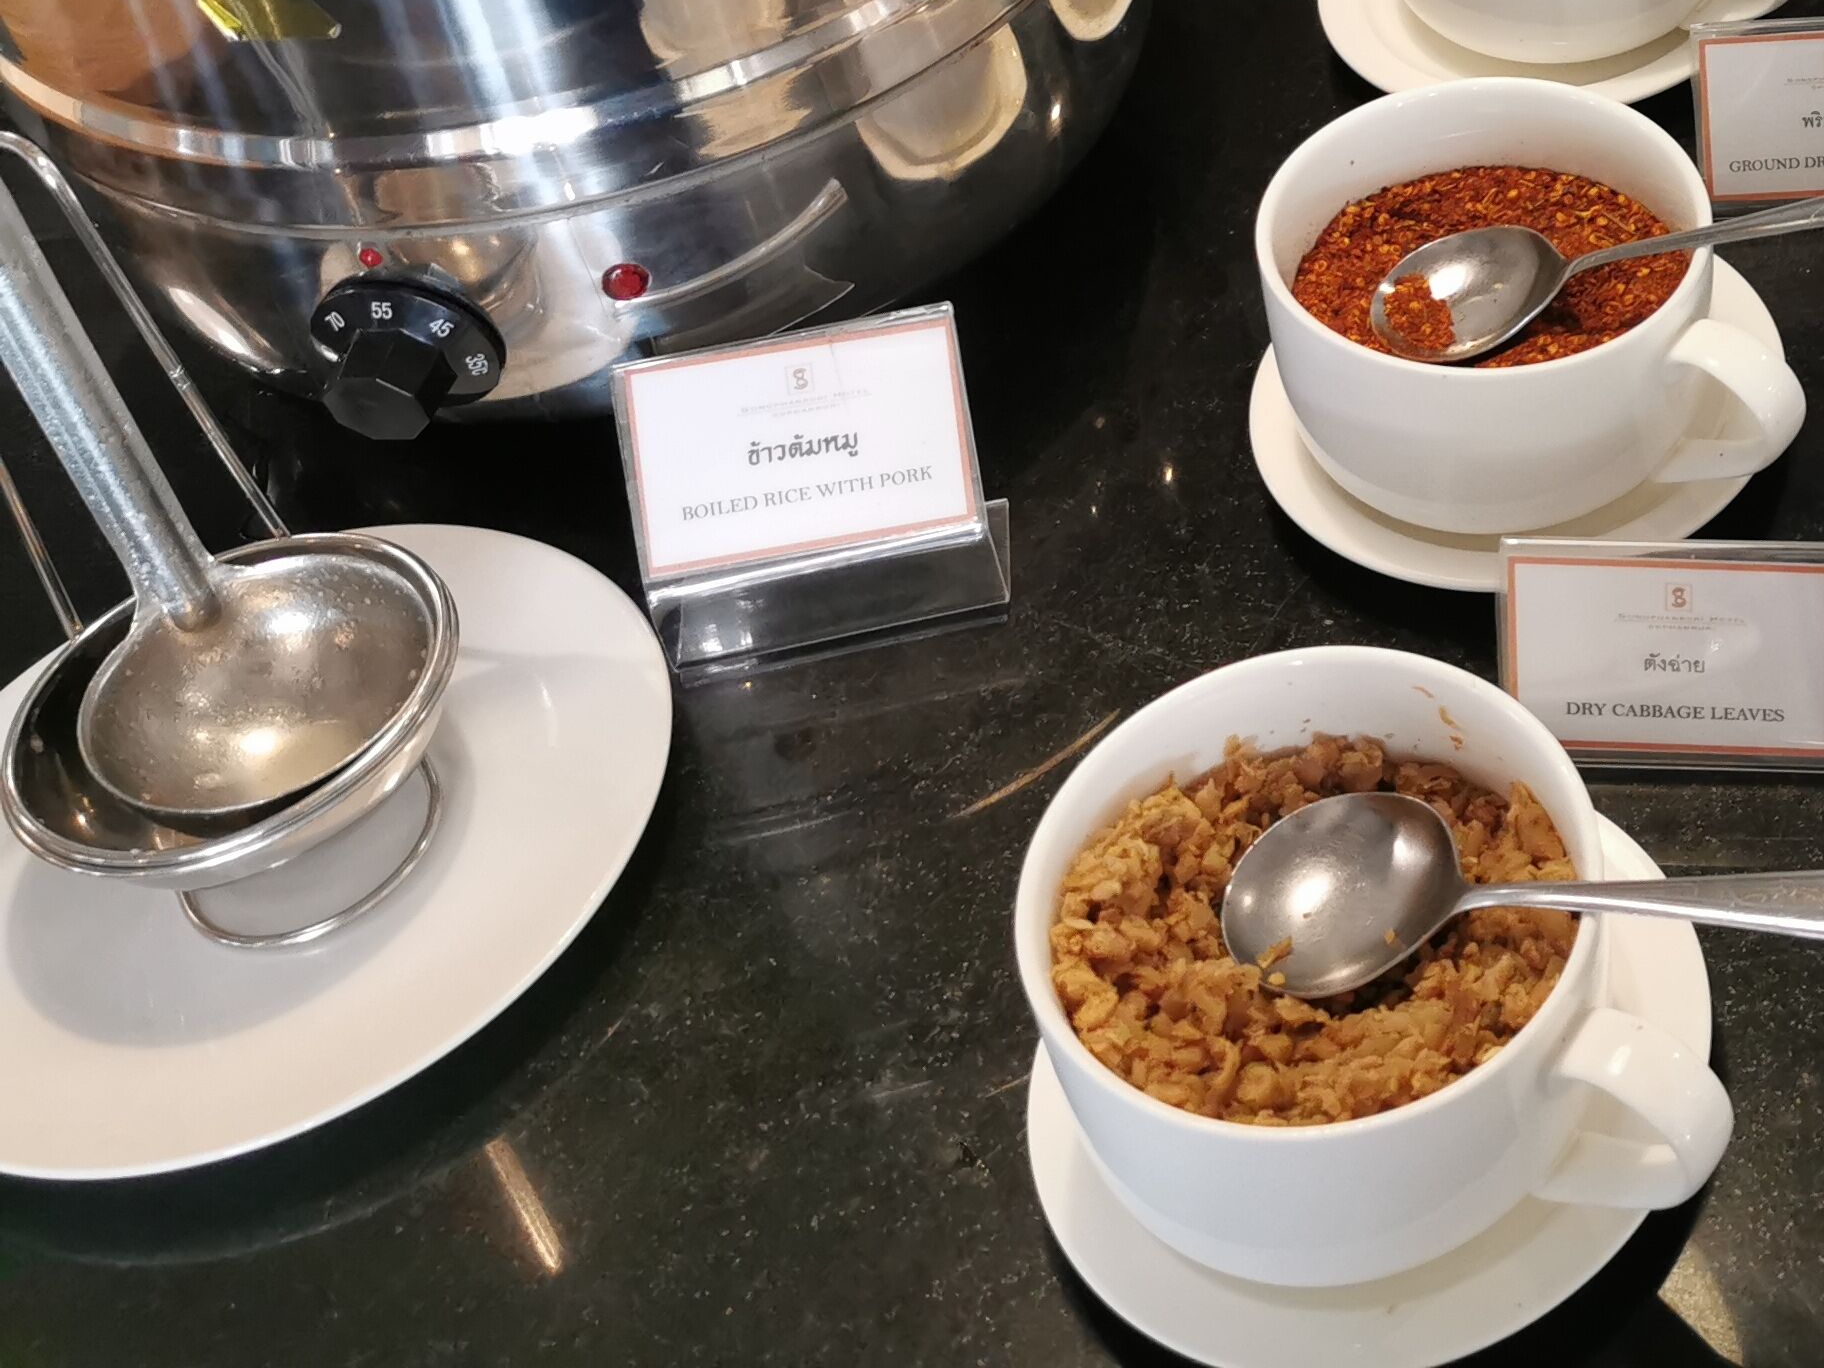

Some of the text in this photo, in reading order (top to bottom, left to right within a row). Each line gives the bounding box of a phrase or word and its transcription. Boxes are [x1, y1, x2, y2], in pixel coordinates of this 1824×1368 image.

[1729, 157, 1801, 173] GROUND
[324, 311, 346, 332] 70
[371, 301, 393, 320] 55
[429, 318, 455, 338] 45
[747, 431, 859, 466] ข้าวต้มหมู
[682, 465, 933, 521] BOILED RICE WITH PORK
[1566, 701, 1785, 722] DRY CABBAGE LEAVES
